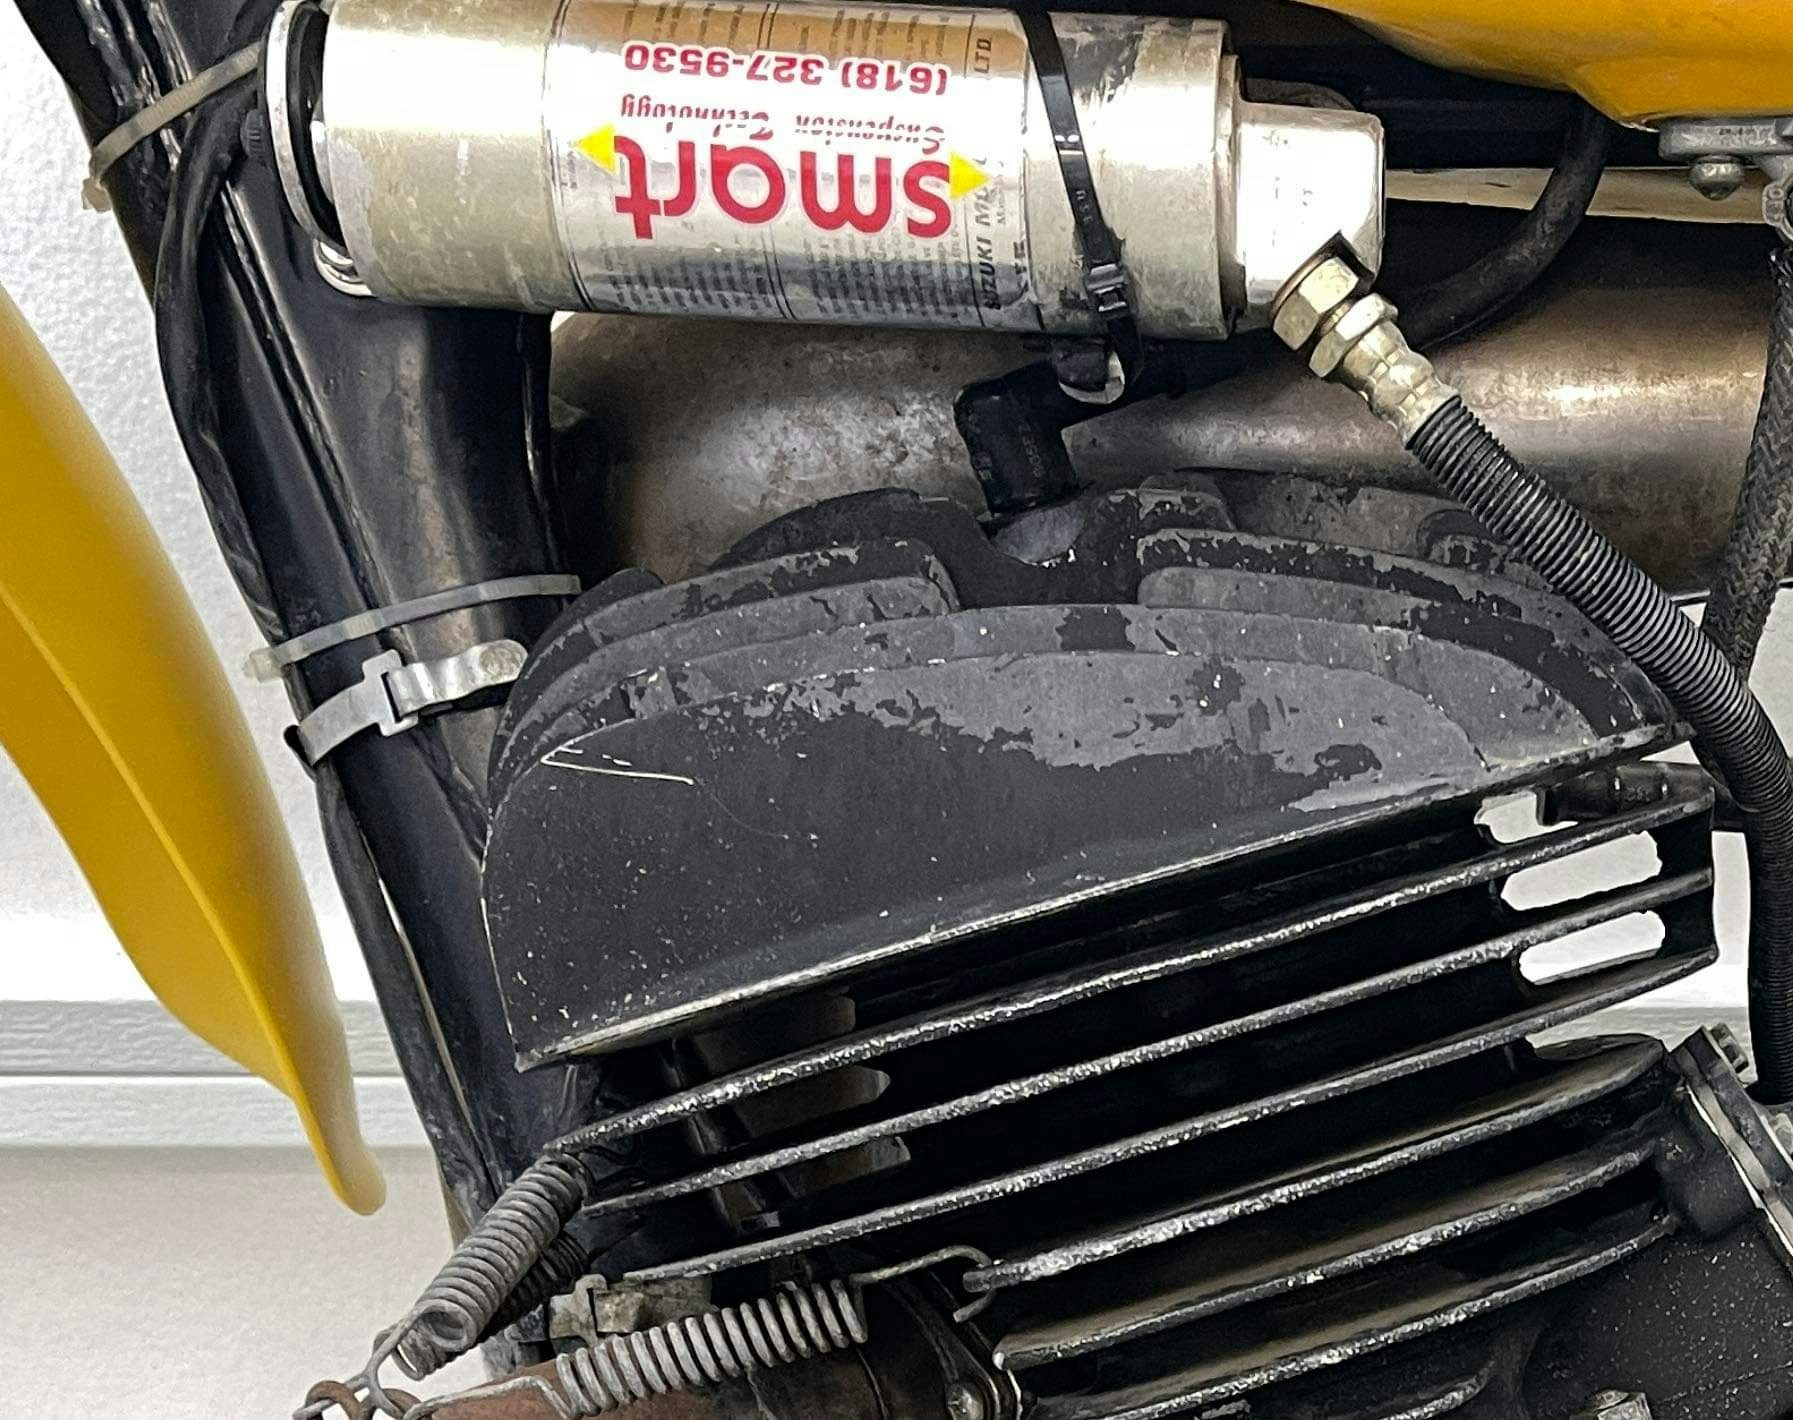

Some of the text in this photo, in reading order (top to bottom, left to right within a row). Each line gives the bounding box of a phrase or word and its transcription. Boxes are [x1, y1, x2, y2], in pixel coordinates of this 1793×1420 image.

[624, 44, 948, 95] (618) 327-9530
[613, 135, 952, 240] smart
